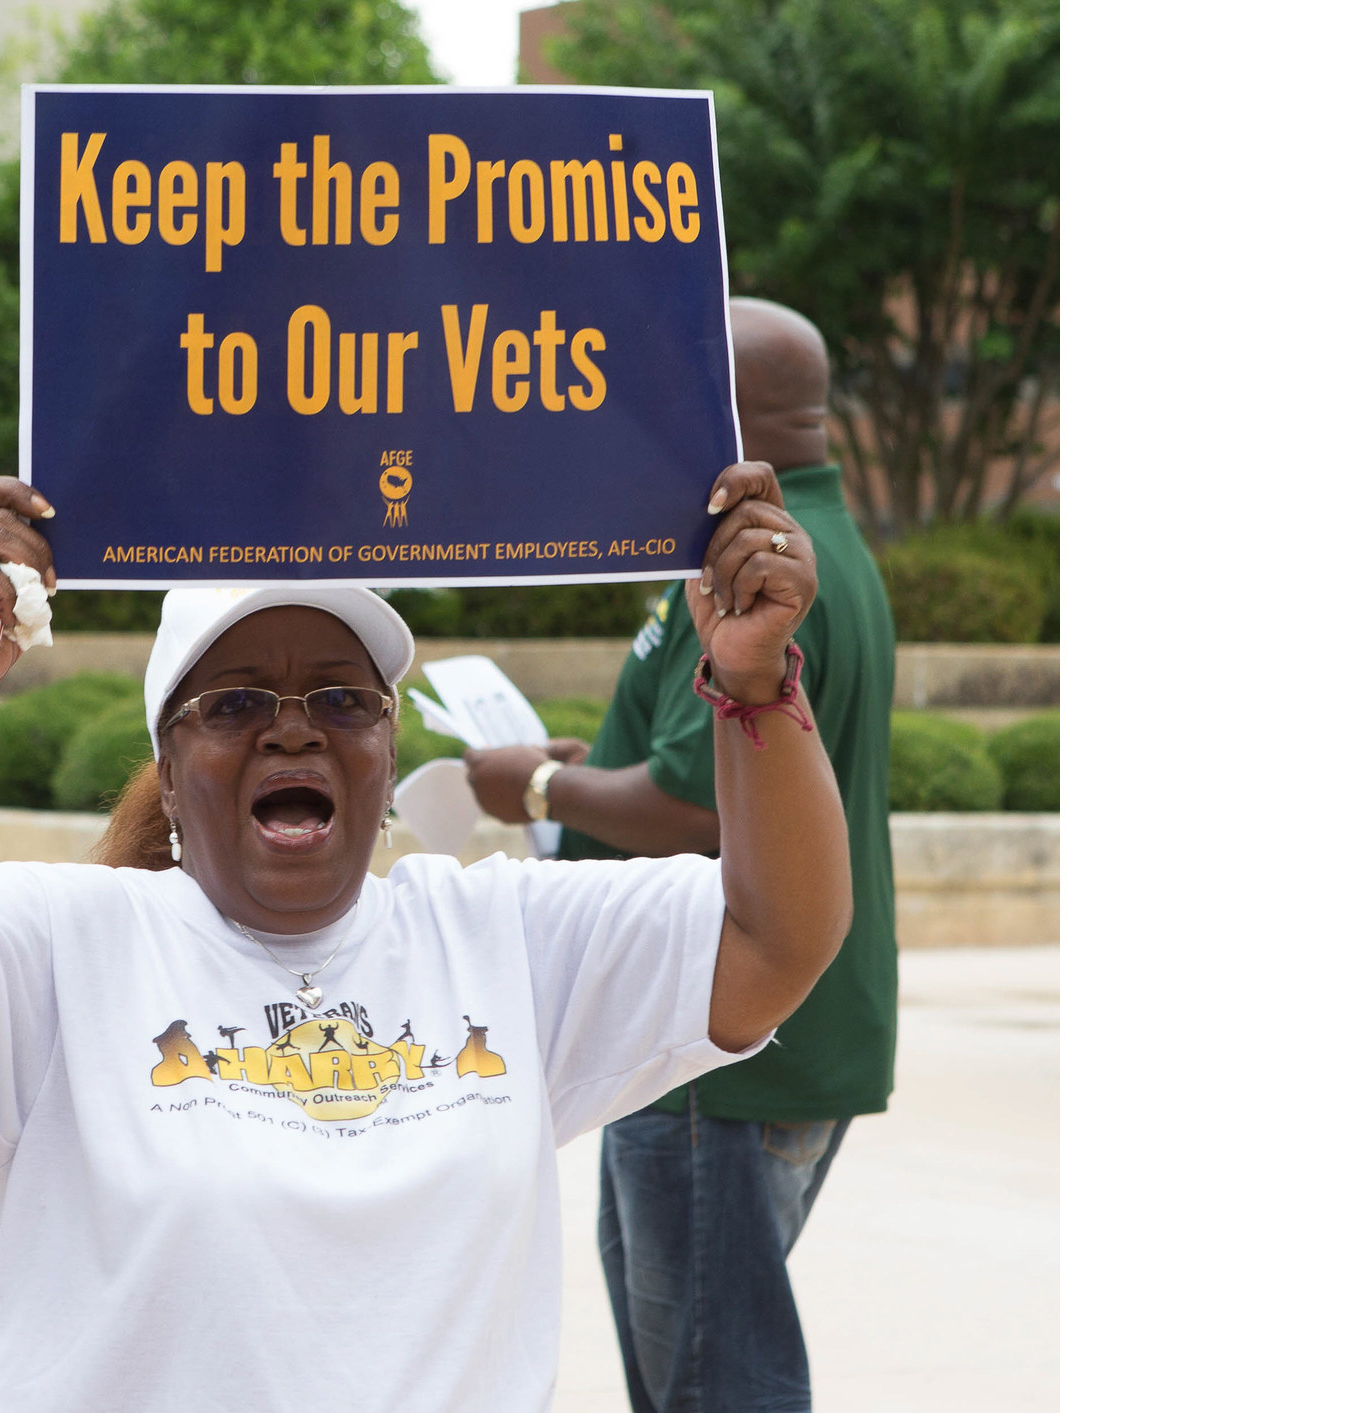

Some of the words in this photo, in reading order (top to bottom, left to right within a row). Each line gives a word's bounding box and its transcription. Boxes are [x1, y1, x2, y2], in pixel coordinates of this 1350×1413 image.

[59, 132, 247, 273] Keep
[273, 134, 401, 247] the
[428, 133, 701, 245] Promise
[180, 313, 259, 416] to
[287, 304, 419, 416] Our
[441, 303, 608, 414] Vets
[380, 449, 413, 466] AFGE
[103, 546, 203, 563] AMERICAN
[209, 546, 322, 563] FEDERATION
[328, 545, 354, 562] OF
[358, 543, 490, 562] GOVERNMENT
[495, 540, 603, 560] EMPLOYEES,
[608, 538, 676, 557] AFL-CIO
[151, 1103, 163, 1112] A
[313, 1093, 377, 1105] Outreach
